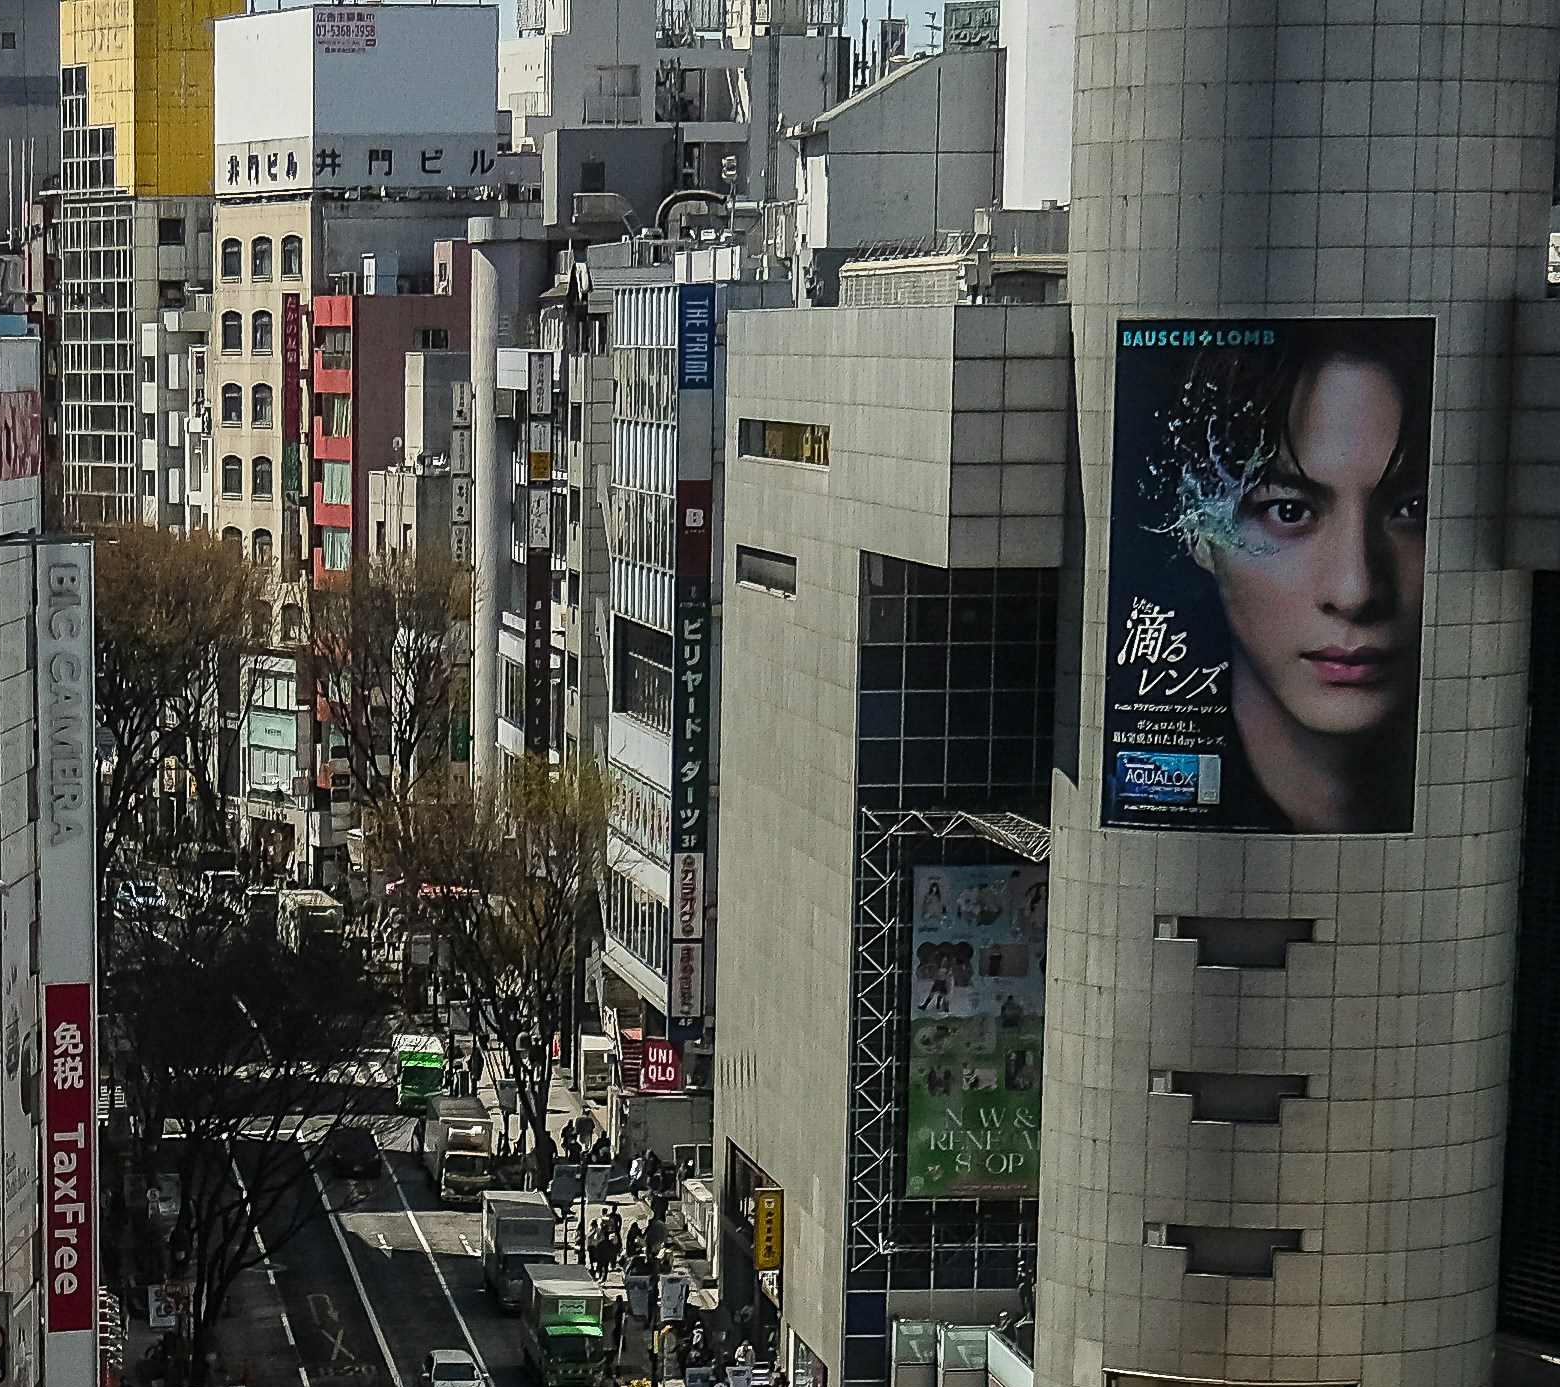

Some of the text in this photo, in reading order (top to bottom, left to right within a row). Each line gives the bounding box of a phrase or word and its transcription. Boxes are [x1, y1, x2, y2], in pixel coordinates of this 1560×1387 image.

[684, 299, 709, 383] THE PRIME
[1122, 328, 1276, 347] BAUSCH LOMB
[1117, 605, 1188, 666] 滴る
[1137, 661, 1229, 700] レンズ
[680, 617, 703, 830] ビリヤード・ダーツ
[647, 1047, 675, 1064] UNI
[647, 1065, 676, 1082] QLO
[51, 1021, 87, 1297] 免税 TaxFree
